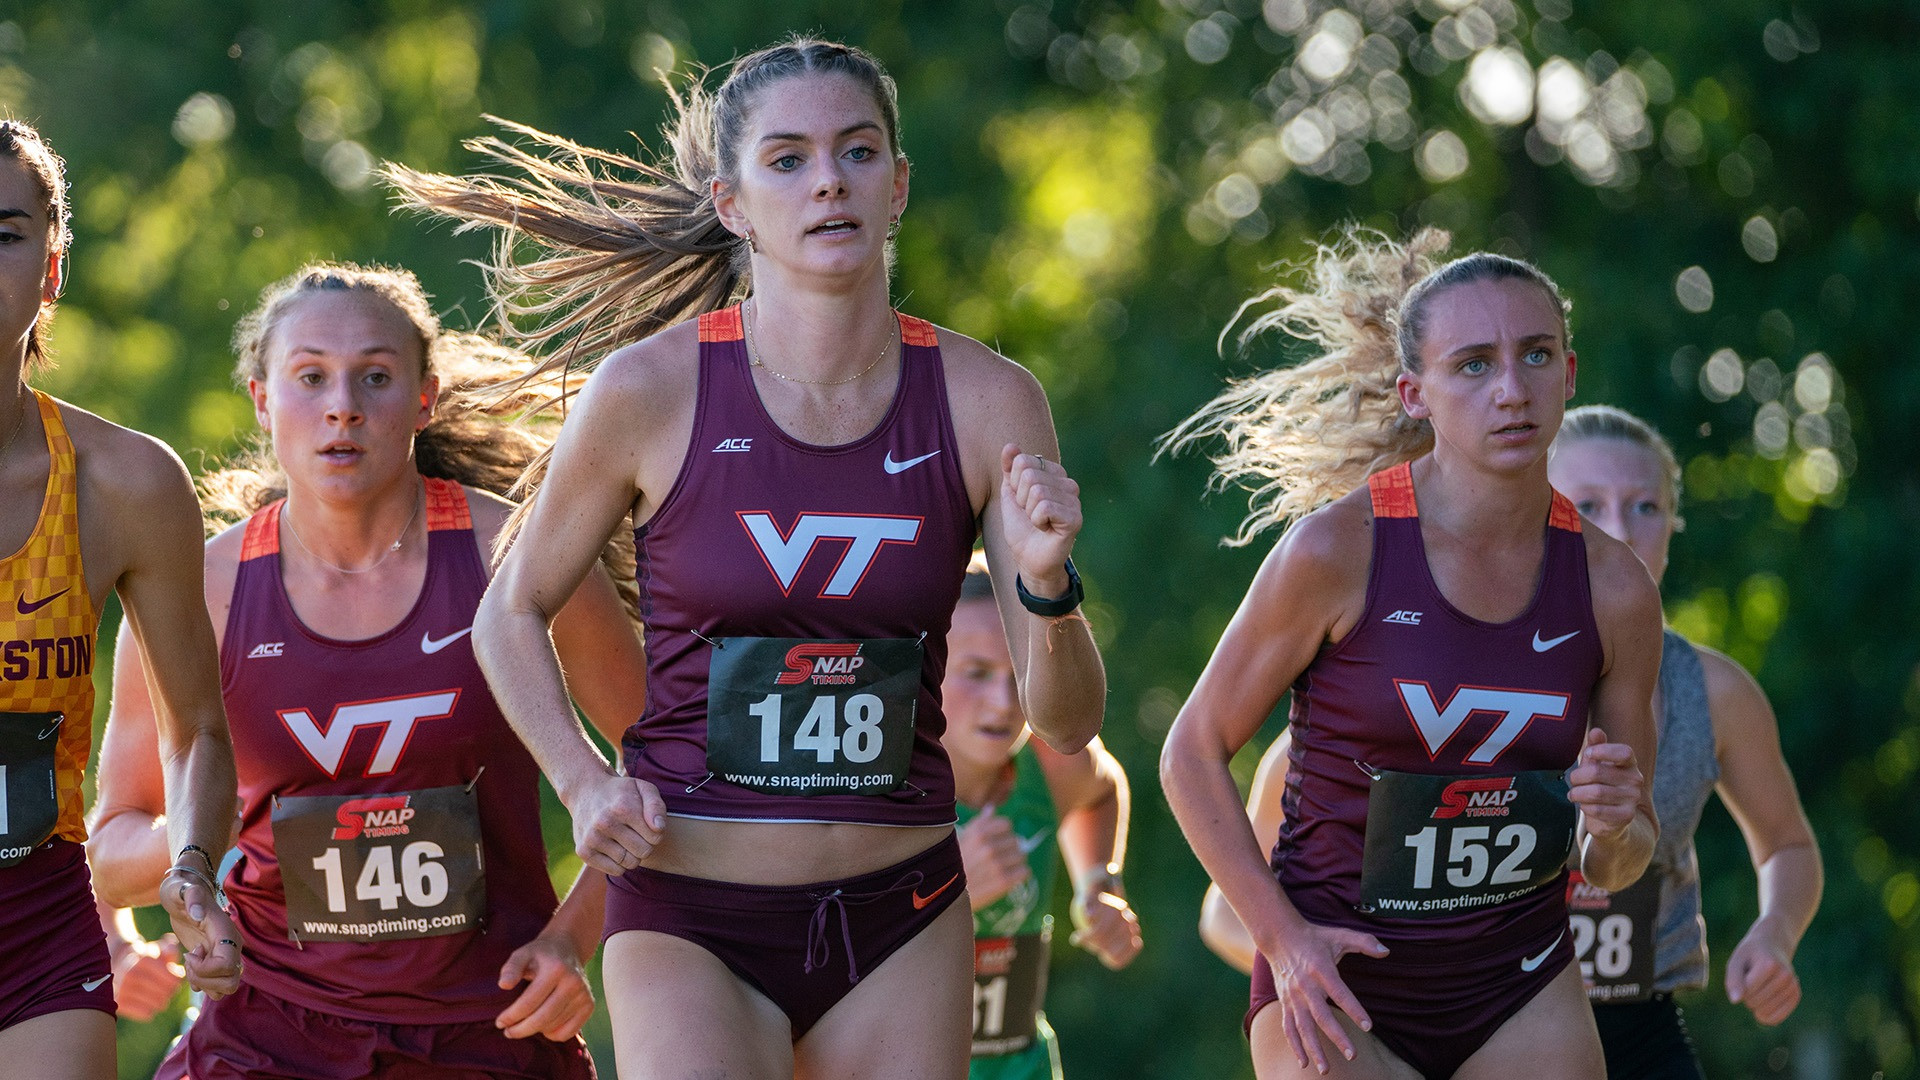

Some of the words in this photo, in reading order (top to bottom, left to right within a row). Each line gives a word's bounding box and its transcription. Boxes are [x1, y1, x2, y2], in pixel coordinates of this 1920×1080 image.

[712, 437, 754, 453] ACC
[735, 510, 925, 600] VT
[1382, 609, 1424, 625] ACC
[0, 633, 91, 682] STON
[248, 642, 285, 658] ACC
[774, 642, 864, 685] SNAP
[811, 674, 856, 685] TIMING
[275, 687, 463, 780] VT
[749, 693, 885, 763] 148
[1392, 678, 1571, 766] VT
[724, 771, 894, 790] www.snaptiming.com
[1430, 776, 1518, 819] SNAP
[331, 795, 415, 840] SNAP
[363, 824, 410, 838] TIMING
[1466, 806, 1510, 818] TIMING
[312, 840, 449, 913] 146
[1404, 823, 1537, 890] 152
[1378, 885, 1538, 913] www.snaptiming.com
[303, 913, 466, 938] www.snaptiming.com
